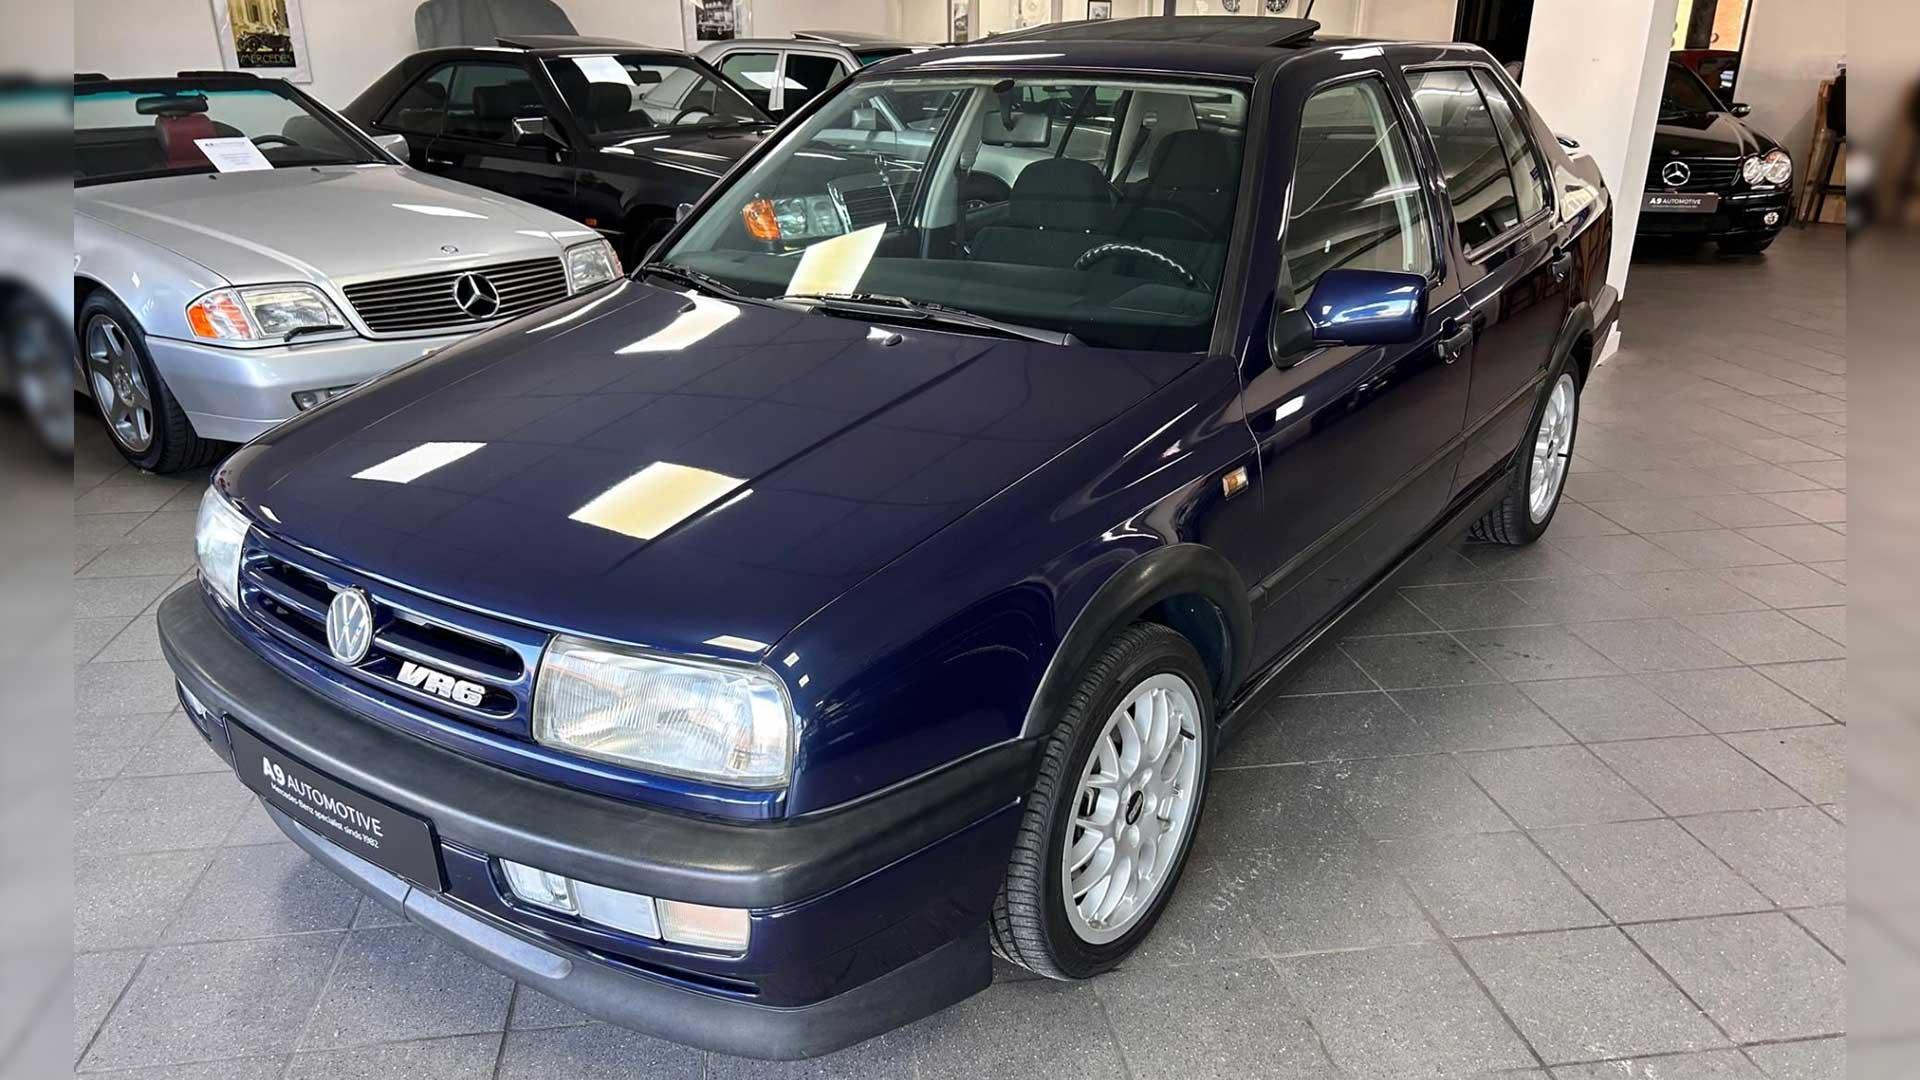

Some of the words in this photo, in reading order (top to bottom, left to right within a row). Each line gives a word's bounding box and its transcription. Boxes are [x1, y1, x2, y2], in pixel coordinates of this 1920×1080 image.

[240, 53, 293, 65] MERCEDES
[1649, 197, 1662, 205] A9
[396, 661, 486, 707] VR6
[263, 756, 286, 786] A9
[287, 774, 384, 837] AUTOMOTIVE
[270, 781, 314, 815] Mercedes-Benz
[314, 808, 344, 831] specialist
[361, 832, 380, 849] 1982
